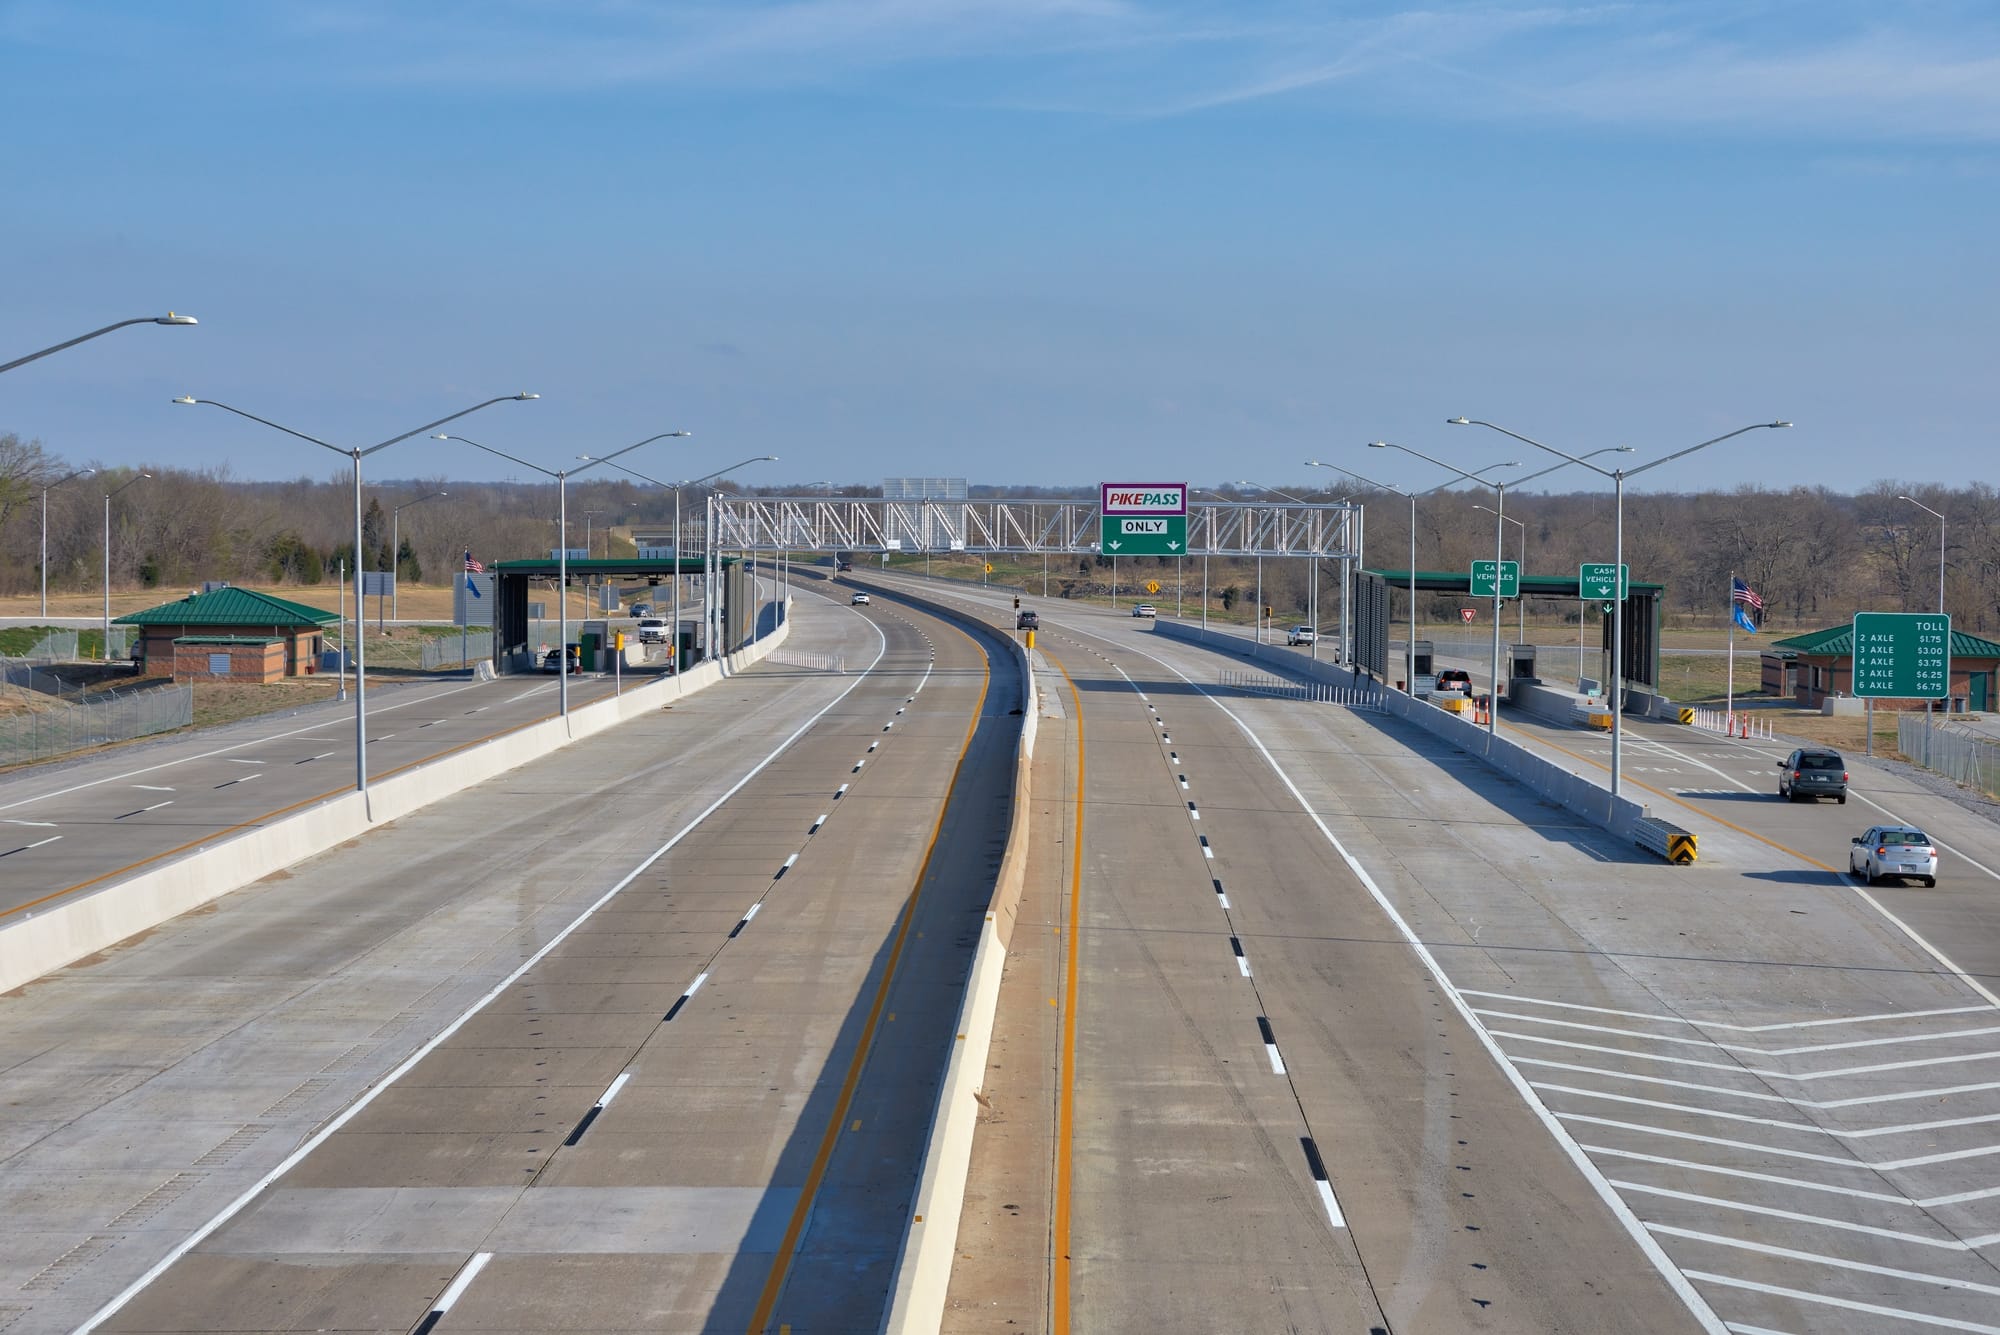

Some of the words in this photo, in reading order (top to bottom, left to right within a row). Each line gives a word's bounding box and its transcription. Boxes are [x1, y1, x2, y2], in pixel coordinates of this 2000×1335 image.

[1109, 493, 1179, 505] PIKEPASS
[1125, 521, 1163, 532] ONLY
[1476, 573, 1514, 581] VEHILES
[1585, 575, 1623, 583] VEHICL
[1916, 622, 1944, 631] TOLL
[1870, 634, 1895, 642] AXLE
[1919, 635, 1942, 643] $1.75
[1870, 646, 1895, 654] AXLE
[1917, 647, 1943, 655] $3.00
[1870, 658, 1895, 666] AXLE
[1918, 659, 1942, 667] $3.75
[1869, 669, 1894, 677] AXLE
[1916, 671, 1943, 679] $6.25
[1869, 681, 1894, 689] AXLE
[1916, 682, 1942, 690] $6.75
